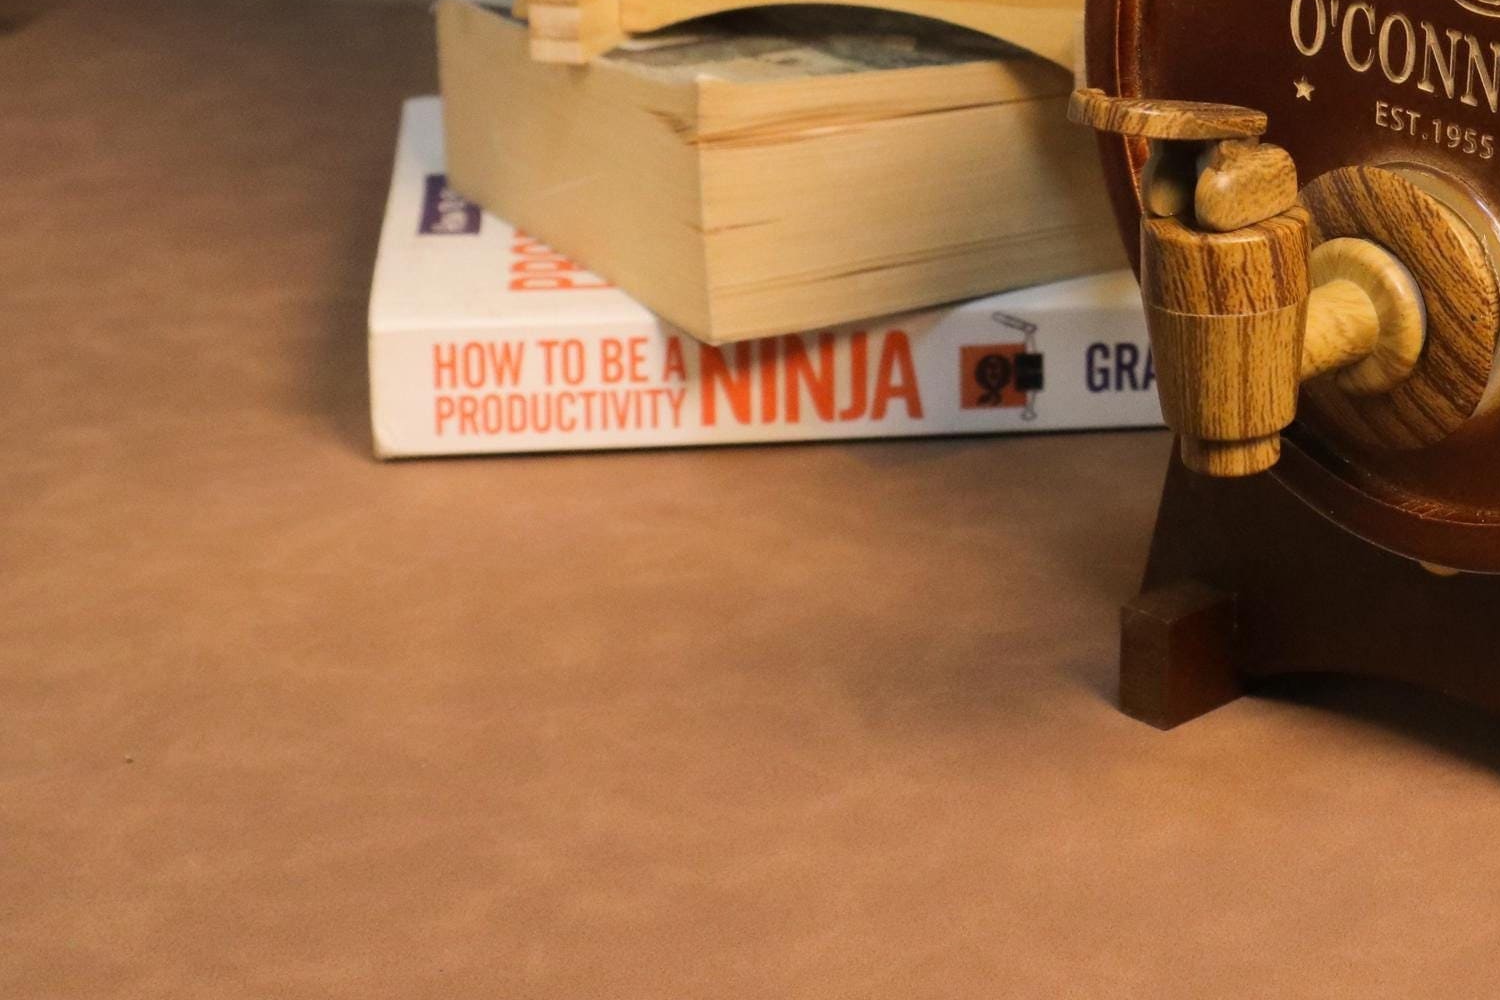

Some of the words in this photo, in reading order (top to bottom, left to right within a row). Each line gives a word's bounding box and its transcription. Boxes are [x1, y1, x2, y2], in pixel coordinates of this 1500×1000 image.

[1375, 100, 1495, 160] EST.1955
[432, 340, 525, 389] HOW
[537, 337, 586, 386] TO
[600, 336, 649, 384] BE
[661, 334, 688, 382] A
[700, 329, 924, 426] NINJA
[433, 386, 688, 437] PRODUCTIVITY
